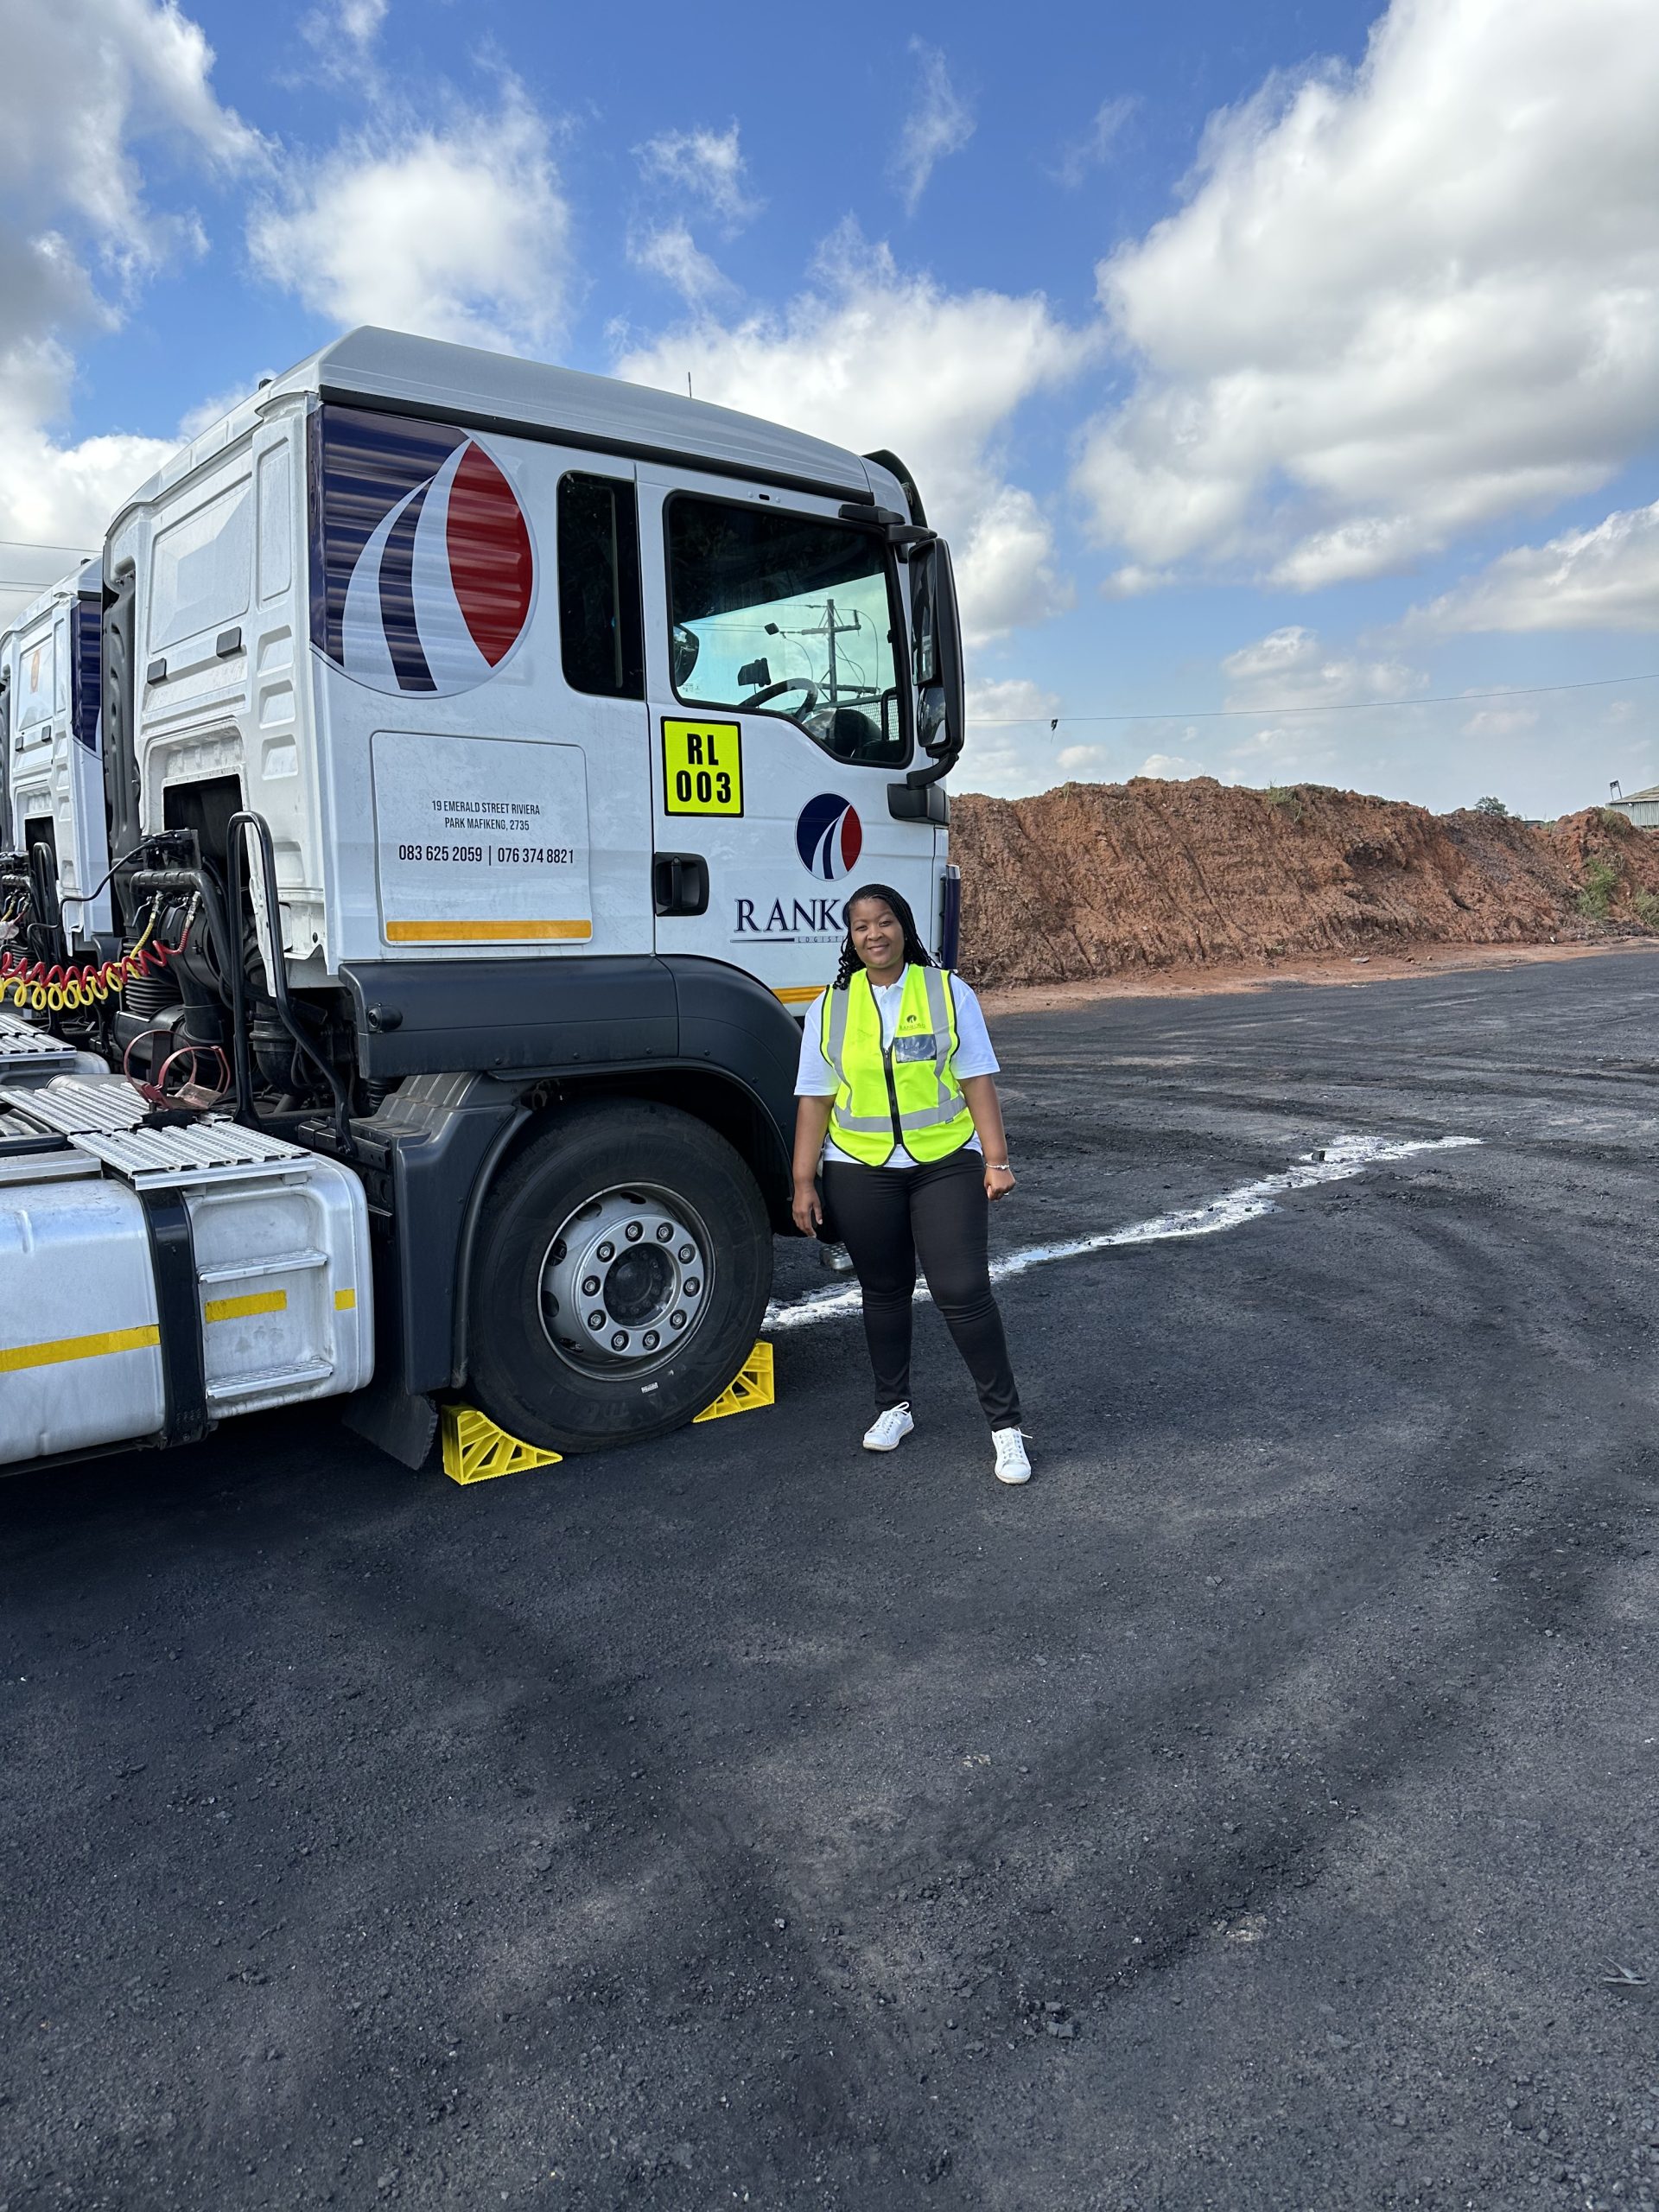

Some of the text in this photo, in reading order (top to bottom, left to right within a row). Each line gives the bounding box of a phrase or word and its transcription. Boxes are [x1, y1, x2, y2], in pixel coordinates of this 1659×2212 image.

[687, 733, 719, 766] RL
[676, 770, 731, 804] 003
[432, 800, 540, 815] 19 EMERALD STREET RIVIERA
[445, 817, 530, 831] PARK MAFIKENG, 2735
[398, 844, 422, 861] 083
[426, 846, 448, 861] 625
[452, 846, 482, 862] 2059
[498, 848, 518, 862] 076
[522, 848, 543, 863] 374
[546, 849, 574, 863] 8821
[734, 897, 850, 933] RANK
